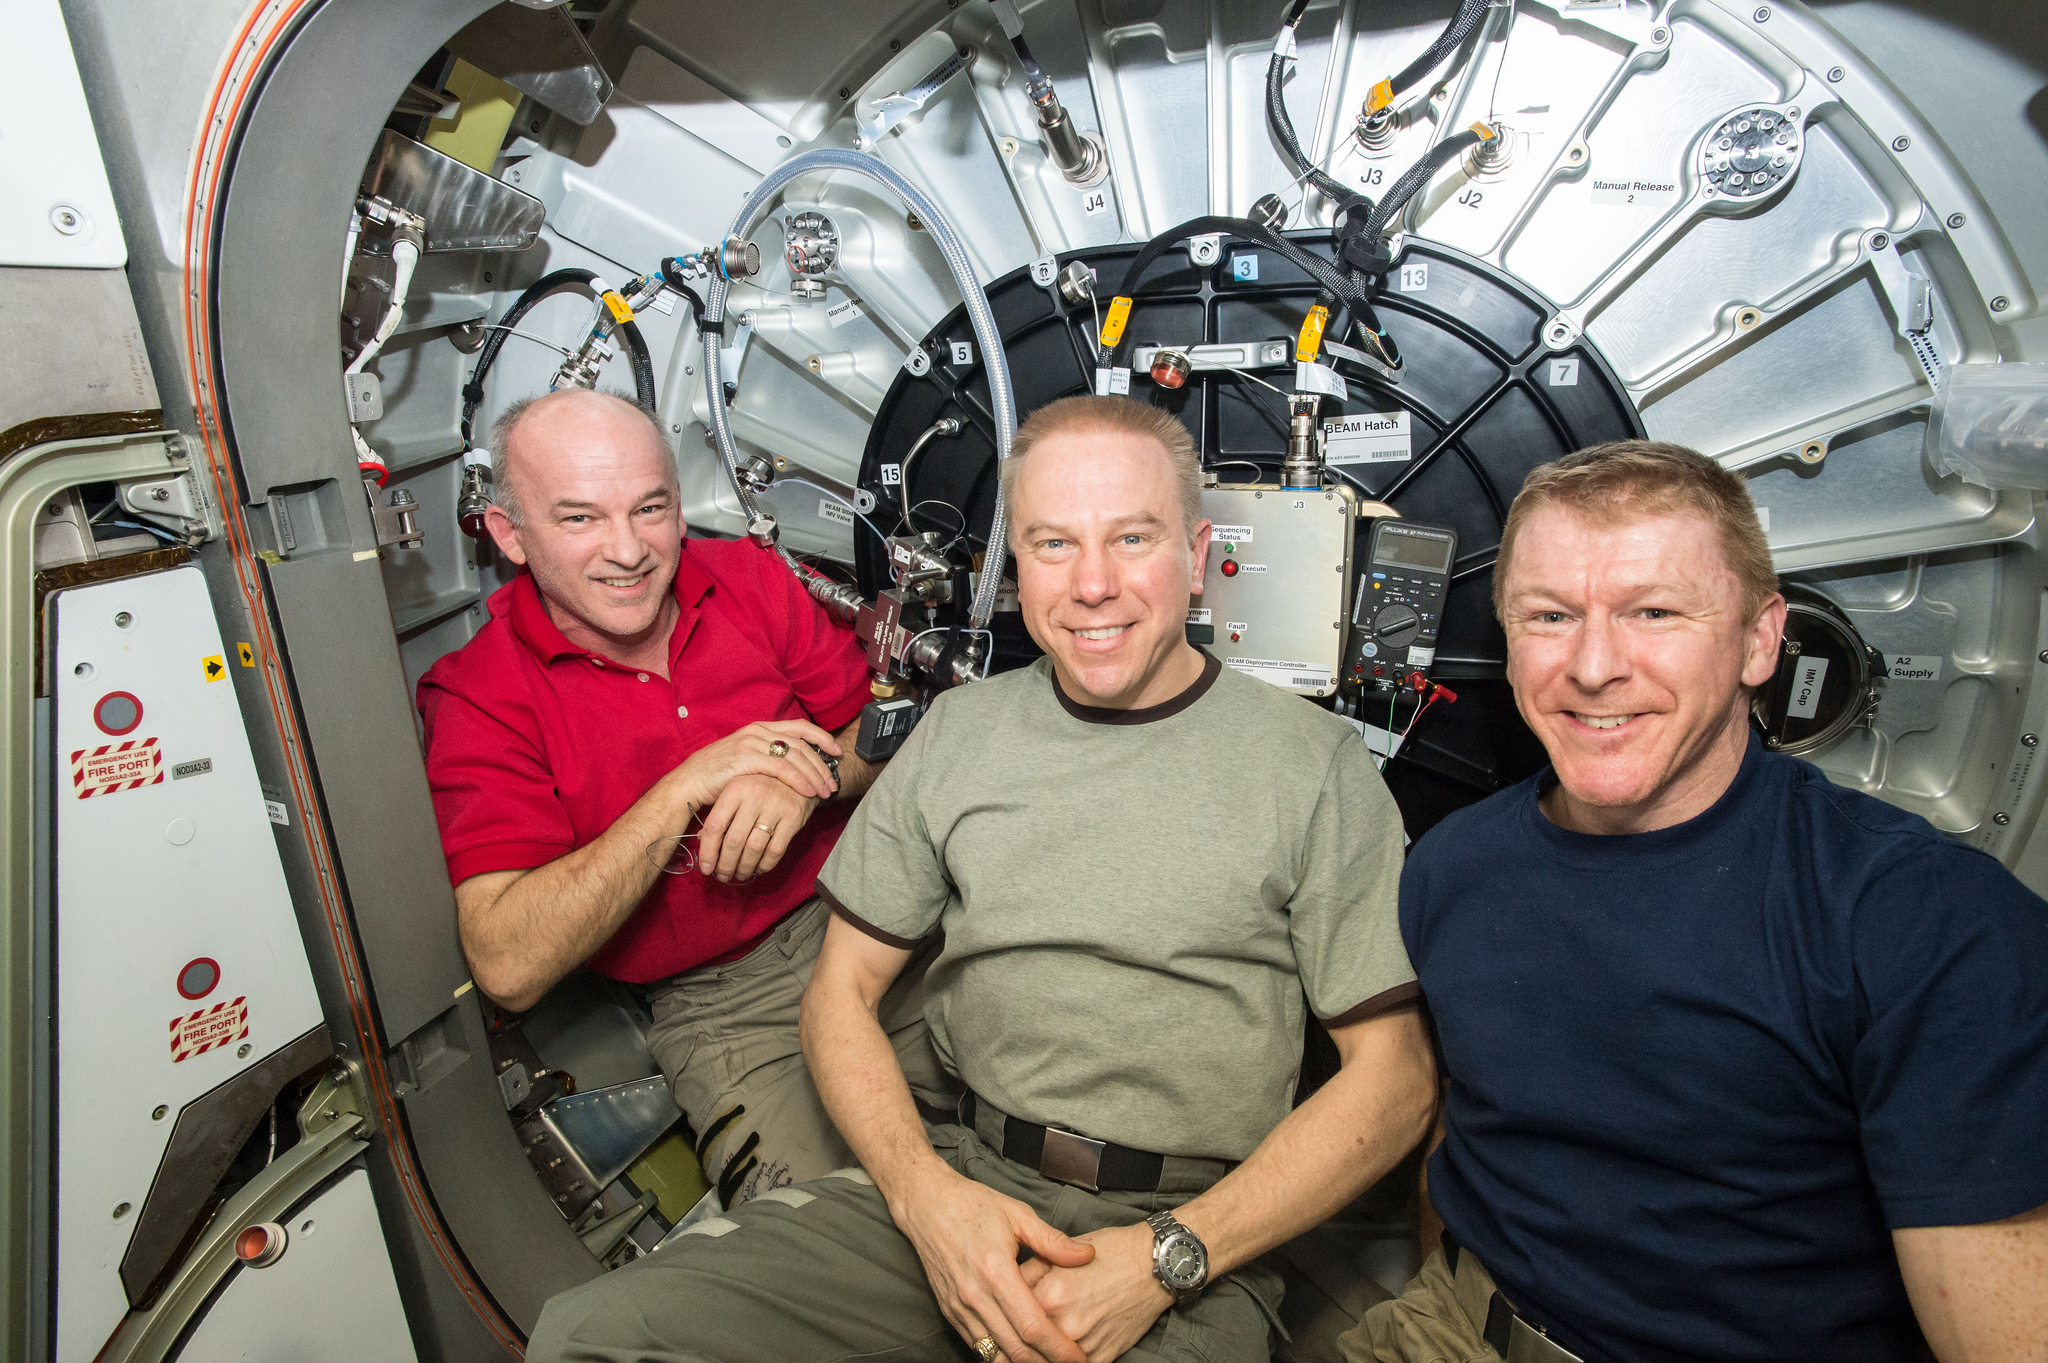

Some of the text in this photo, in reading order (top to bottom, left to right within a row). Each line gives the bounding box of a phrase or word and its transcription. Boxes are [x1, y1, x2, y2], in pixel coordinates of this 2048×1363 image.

[1360, 168, 1383, 185] J3
[1592, 181, 1675, 191] Manual Release
[1086, 193, 1105, 212] J4
[1458, 189, 1483, 209] J2
[1627, 194, 1634, 203] 2
[1240, 260, 1251, 277] 3
[1403, 269, 1426, 286] 13
[828, 302, 850, 317] Manual
[958, 346, 967, 360] 5
[1558, 365, 1571, 381] 7
[1325, 419, 1399, 434] BEAM Hatch
[883, 468, 899, 481] 15
[824, 502, 841, 512] BEAM
[1293, 501, 1304, 509] J3
[836, 513, 851, 523] Valve
[1211, 526, 1251, 535] Sequencing
[1218, 533, 1241, 541] Status
[1385, 526, 1408, 535] FLUKE
[1245, 659, 1278, 667] Deployment
[1896, 657, 1912, 665] A2
[1894, 668, 1934, 678] Supply
[1799, 668, 1817, 706] IMV Cap
[87, 750, 148, 767] EMERGENCY USE
[88, 758, 151, 779] FIRE PORT
[176, 761, 211, 776] NOD3A2-33
[183, 1009, 236, 1032] EMERGENCY USE
[183, 1016, 238, 1042] FIRE PORT
